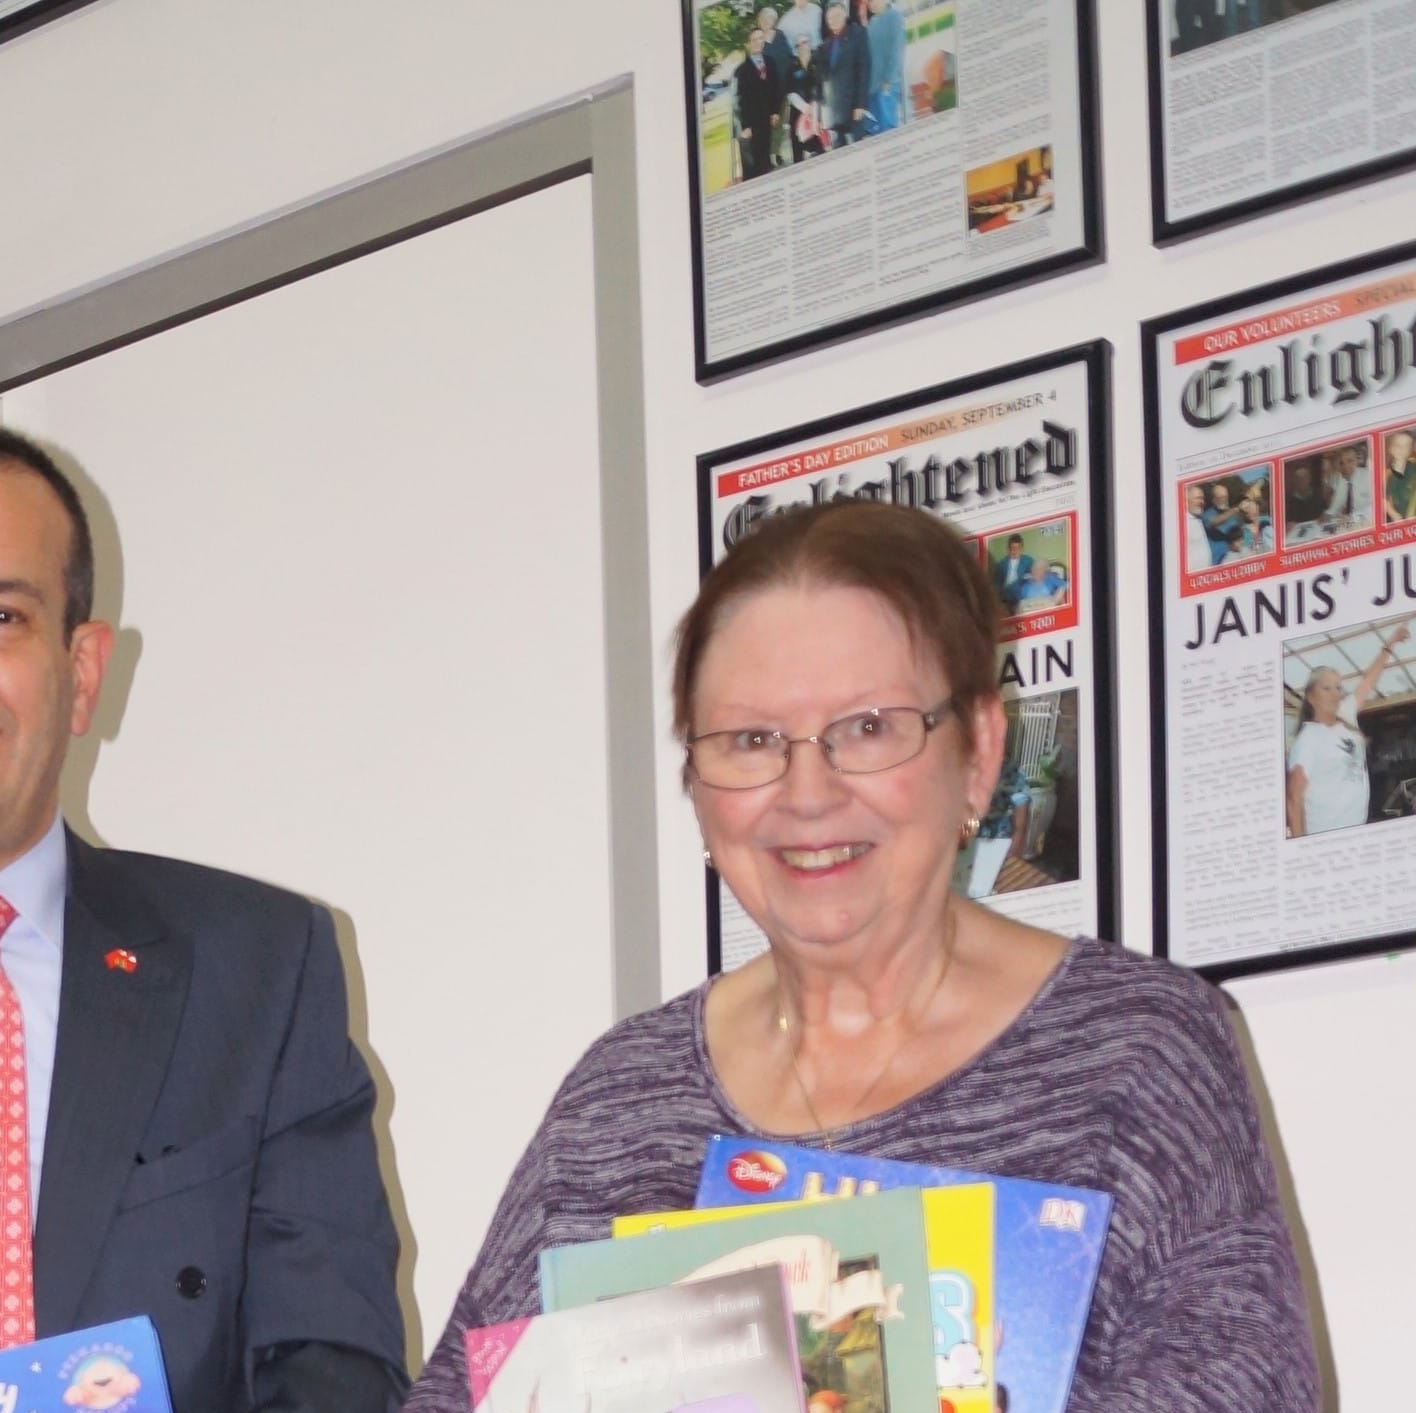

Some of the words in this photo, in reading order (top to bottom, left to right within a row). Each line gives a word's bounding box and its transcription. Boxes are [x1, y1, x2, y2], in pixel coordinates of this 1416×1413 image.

[1204, 330, 1239, 352] OUR
[1239, 300, 1342, 342] VOLUNTEERS
[1181, 313, 1416, 428] Enligh
[737, 456, 802, 488] FATHER'S
[804, 451, 831, 470] DAY
[833, 435, 889, 463] EDITION
[961, 393, 1044, 425] SEPTEMBER
[1184, 567, 1351, 650] JANIS'
[731, 1158, 783, 1190] Disney
